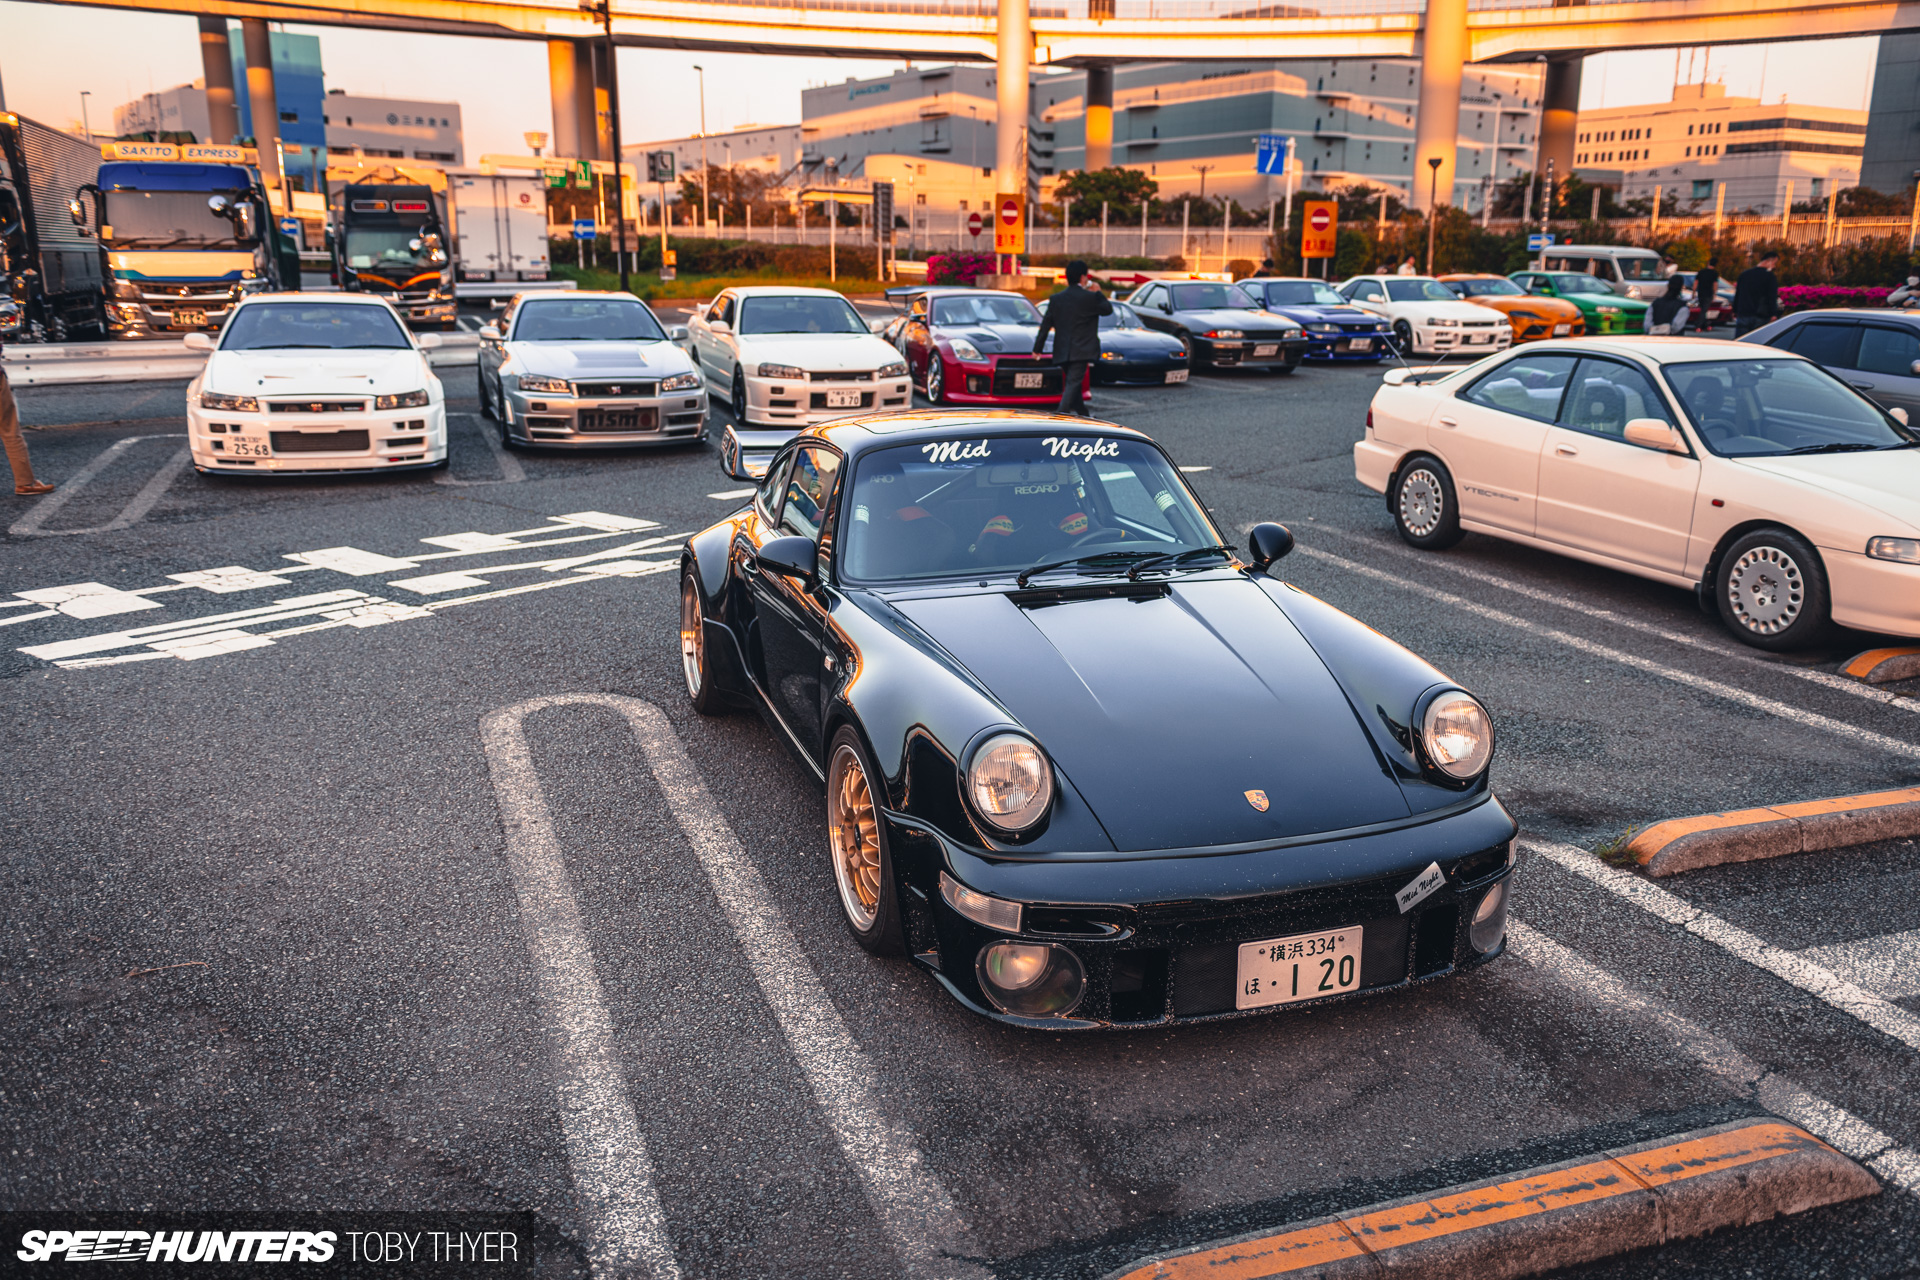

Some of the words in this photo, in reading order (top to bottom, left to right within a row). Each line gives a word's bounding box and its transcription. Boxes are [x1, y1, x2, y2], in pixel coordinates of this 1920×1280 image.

[121, 146, 172, 157] SAKITO
[188, 148, 239, 159] EXPRESS
[234, 443, 269, 455] 25-68
[922, 439, 991, 463] Mid
[1041, 437, 1119, 462] Night
[1014, 484, 1060, 495] RECARO
[1401, 887, 1418, 904] Mid
[1419, 871, 1439, 891] Night
[1270, 936, 1335, 962] 横浜334
[1245, 978, 1260, 995] ほ
